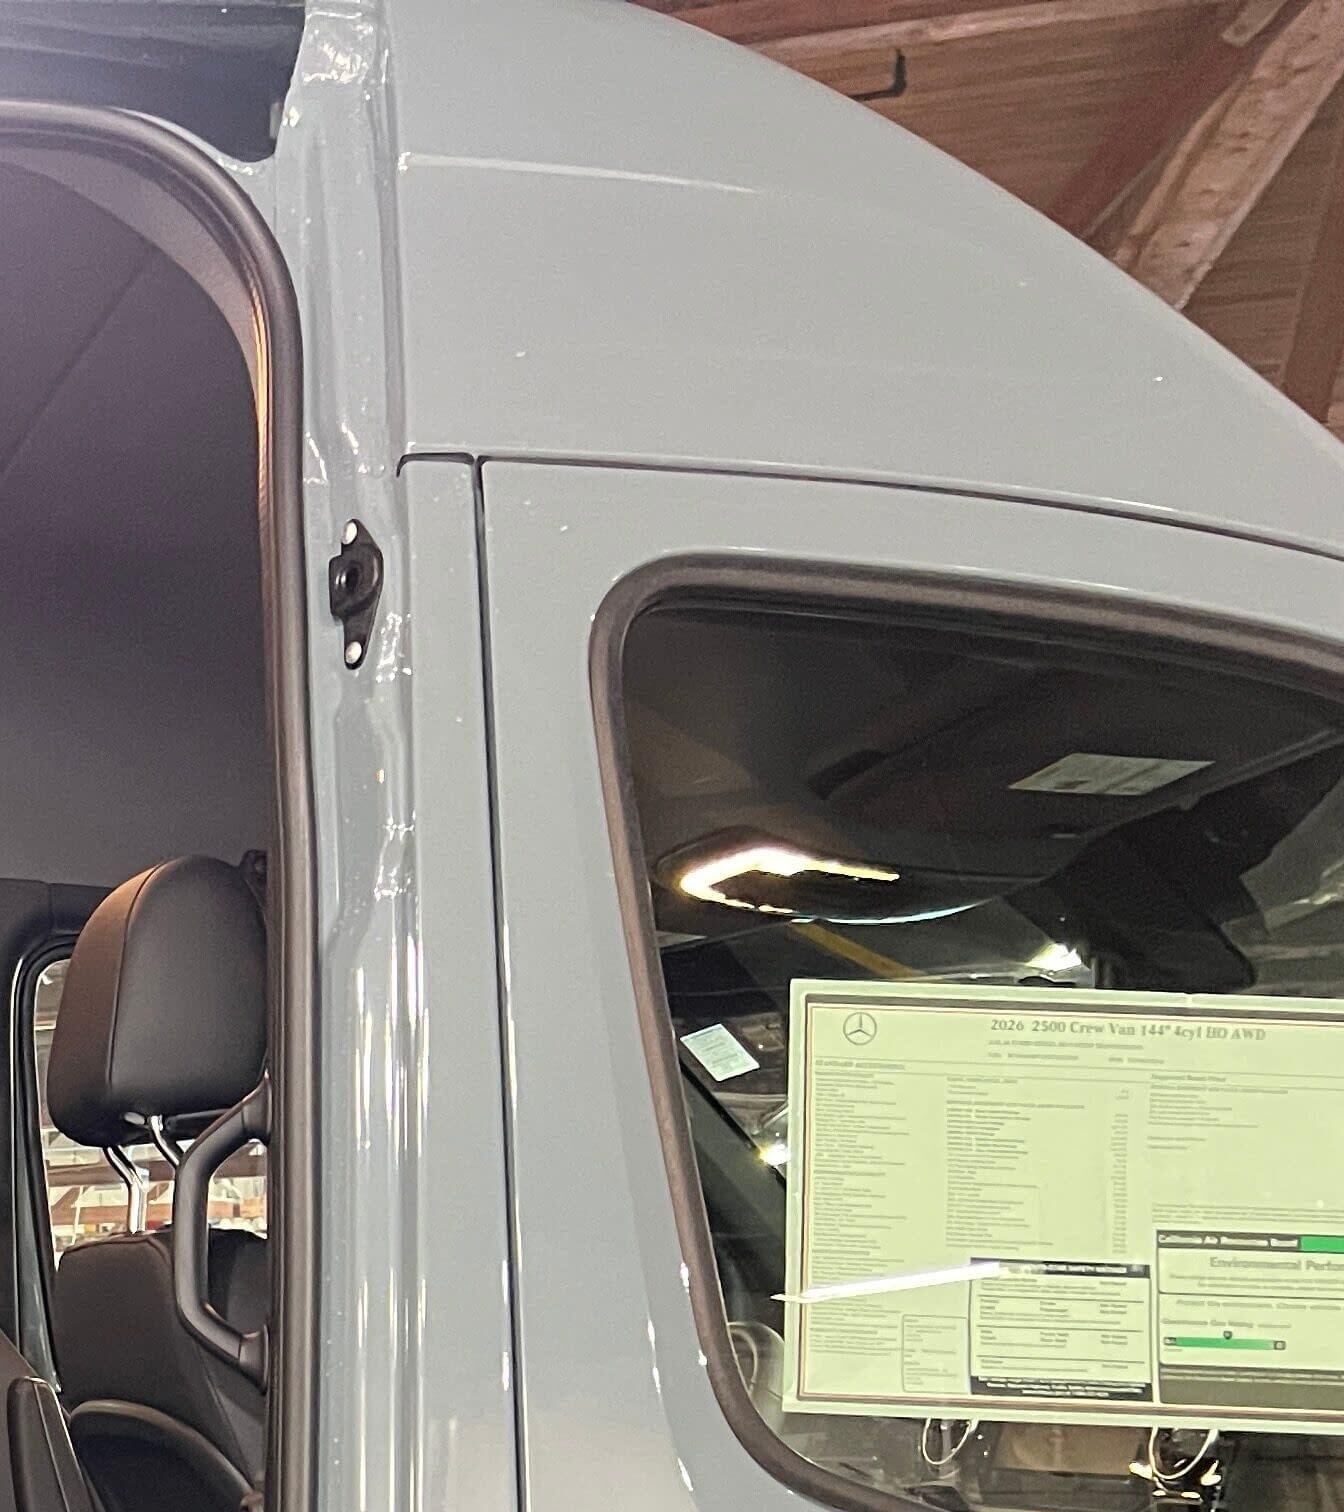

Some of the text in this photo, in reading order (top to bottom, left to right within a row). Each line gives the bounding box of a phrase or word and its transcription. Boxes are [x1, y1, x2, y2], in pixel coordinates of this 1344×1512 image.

[990, 1019, 1025, 1031] 2026
[1031, 1020, 1067, 1033] 2500
[1069, 1021, 1105, 1034] Crew
[1108, 1022, 1135, 1036] Van
[1231, 1027, 1267, 1041] AWD
